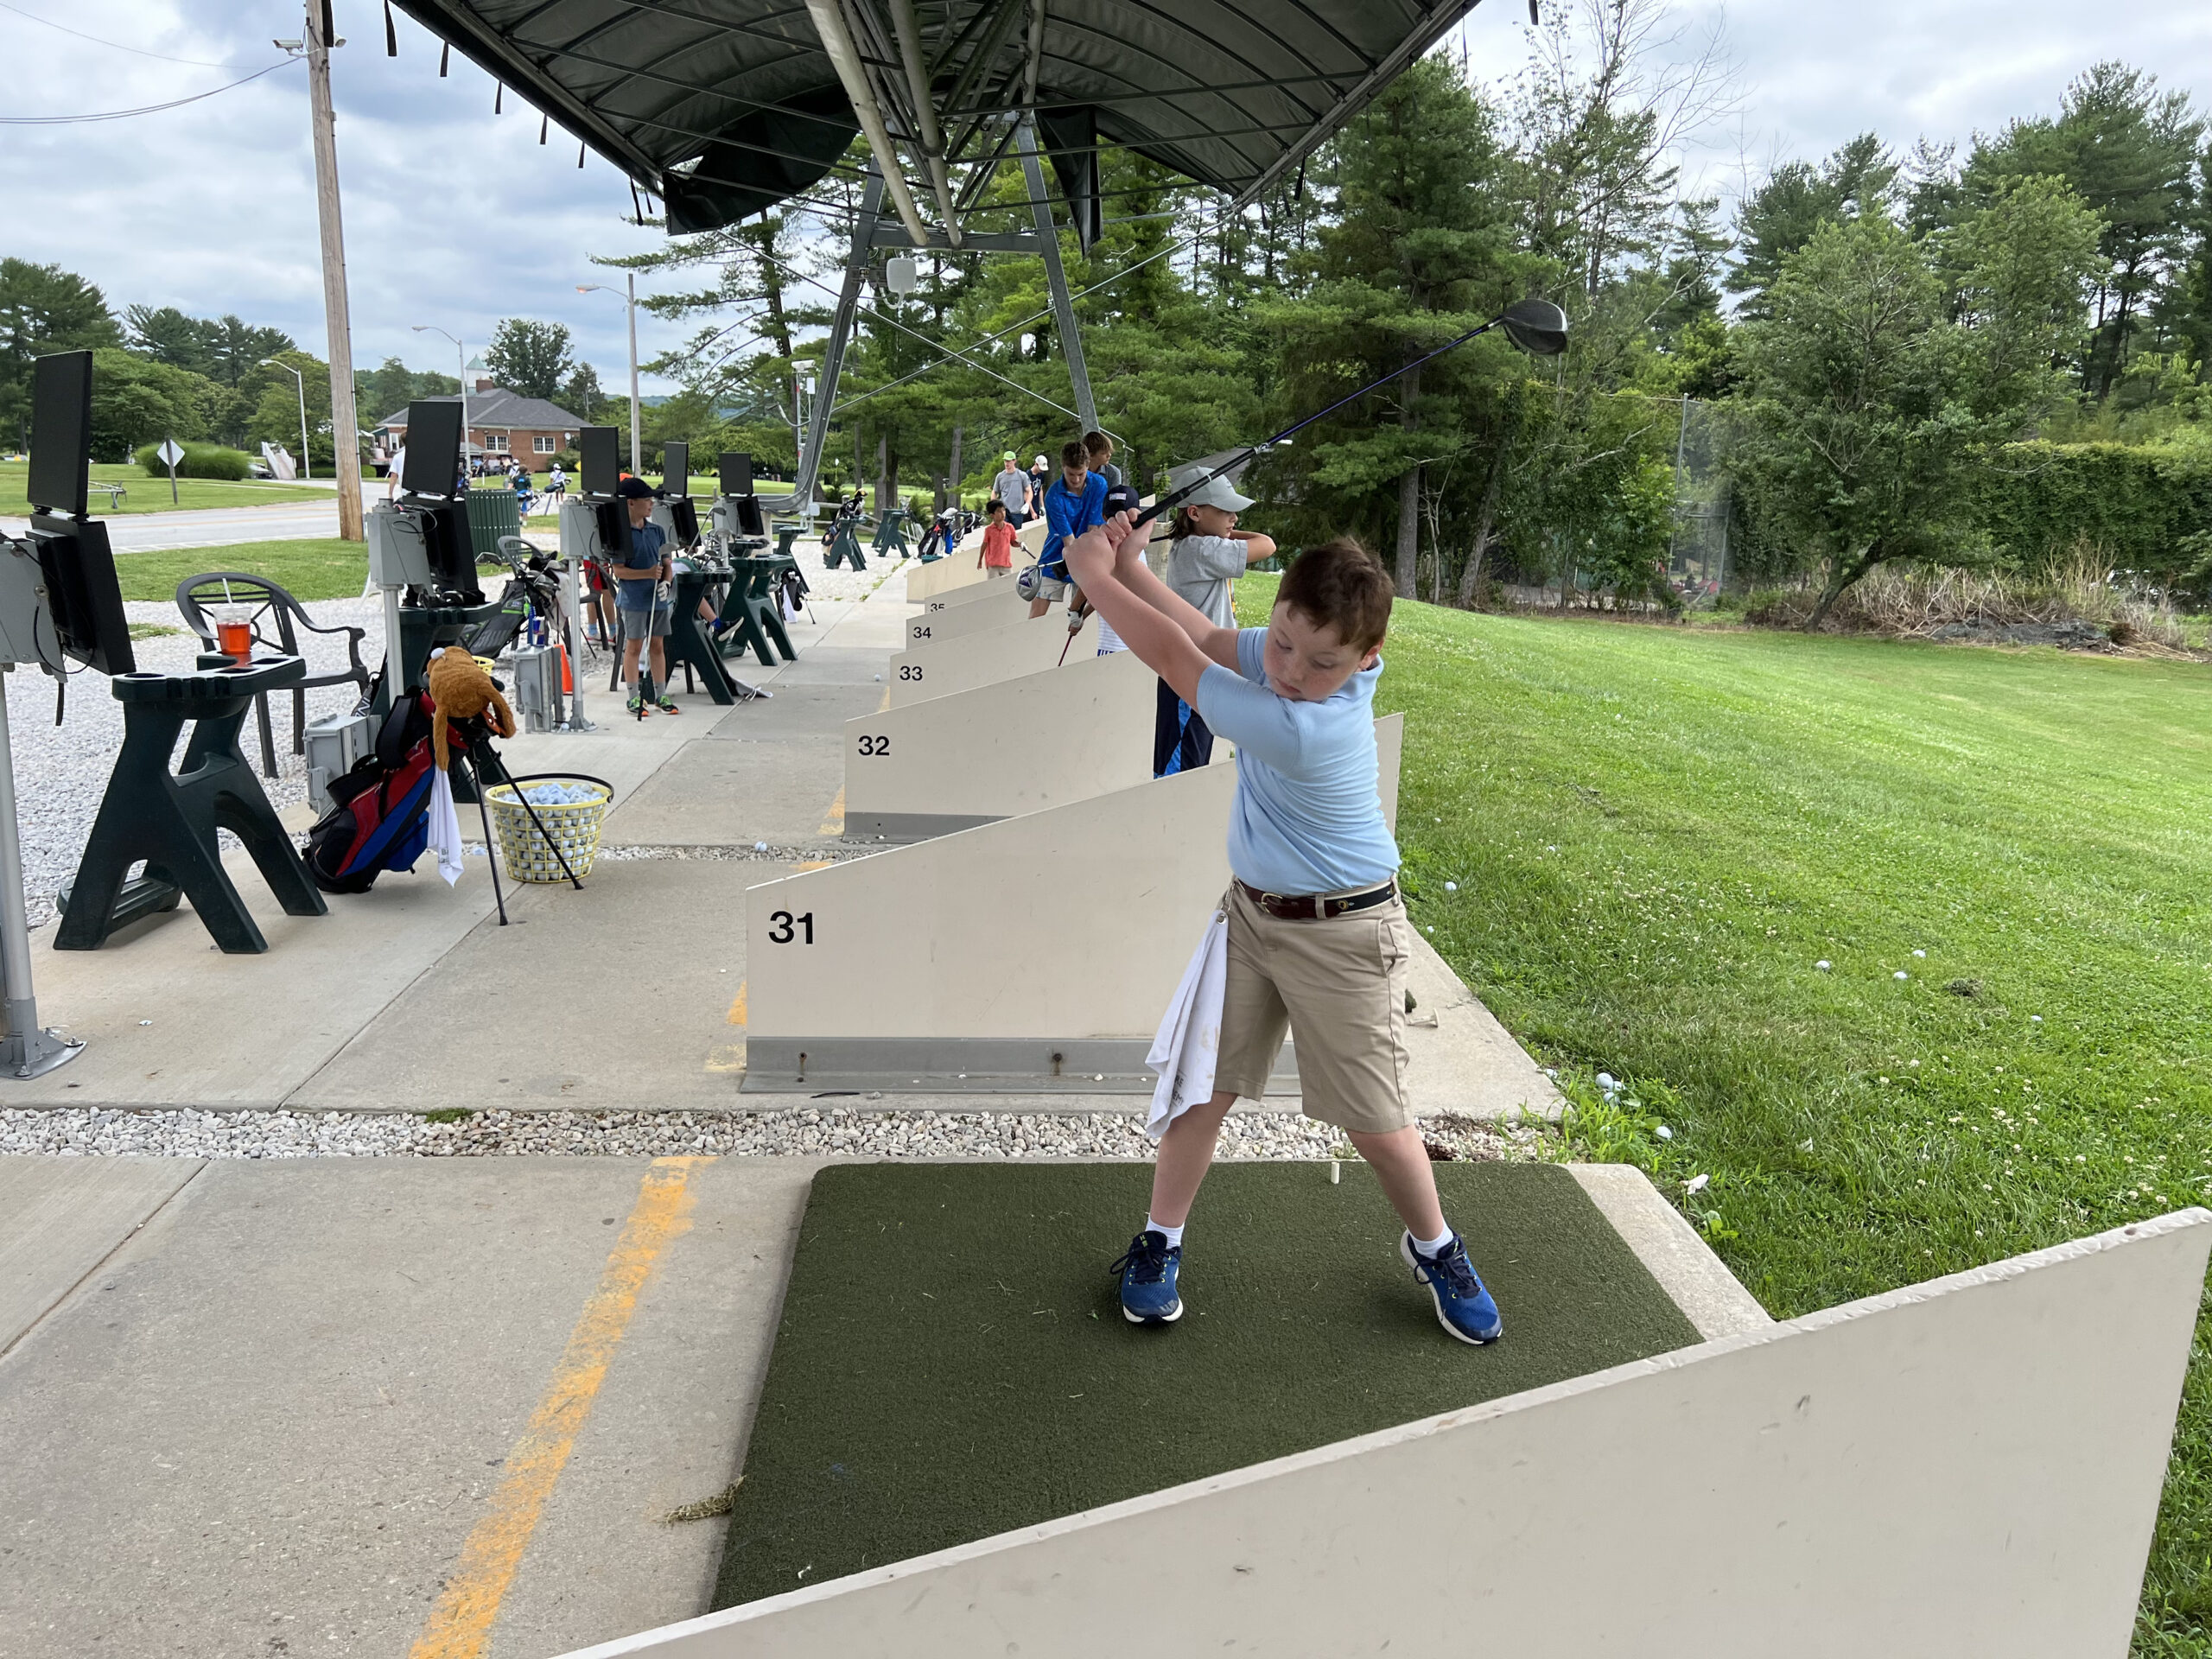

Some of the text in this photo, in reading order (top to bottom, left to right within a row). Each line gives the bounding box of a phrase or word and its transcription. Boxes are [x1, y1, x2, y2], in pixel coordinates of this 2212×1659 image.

[912, 626, 932, 639] 34
[899, 665, 923, 682] 33
[858, 734, 890, 757] 32
[768, 911, 813, 945] 31
